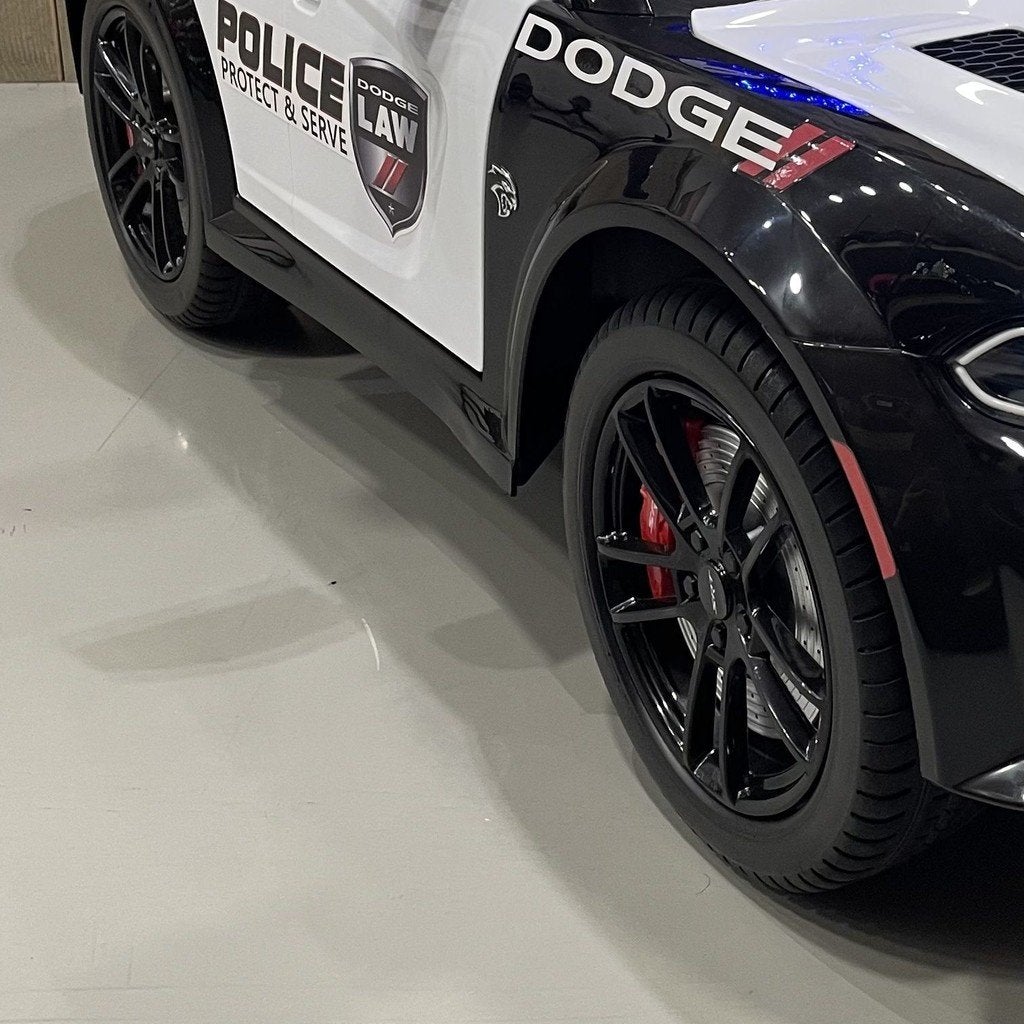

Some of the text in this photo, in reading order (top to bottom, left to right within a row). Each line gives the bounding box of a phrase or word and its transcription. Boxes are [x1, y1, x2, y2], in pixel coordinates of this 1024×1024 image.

[220, 56, 348, 155] PROTECT & SERVE
[357, 78, 419, 116] DODGE
[357, 94, 419, 154] LAW
[514, 13, 794, 172] DODGE
